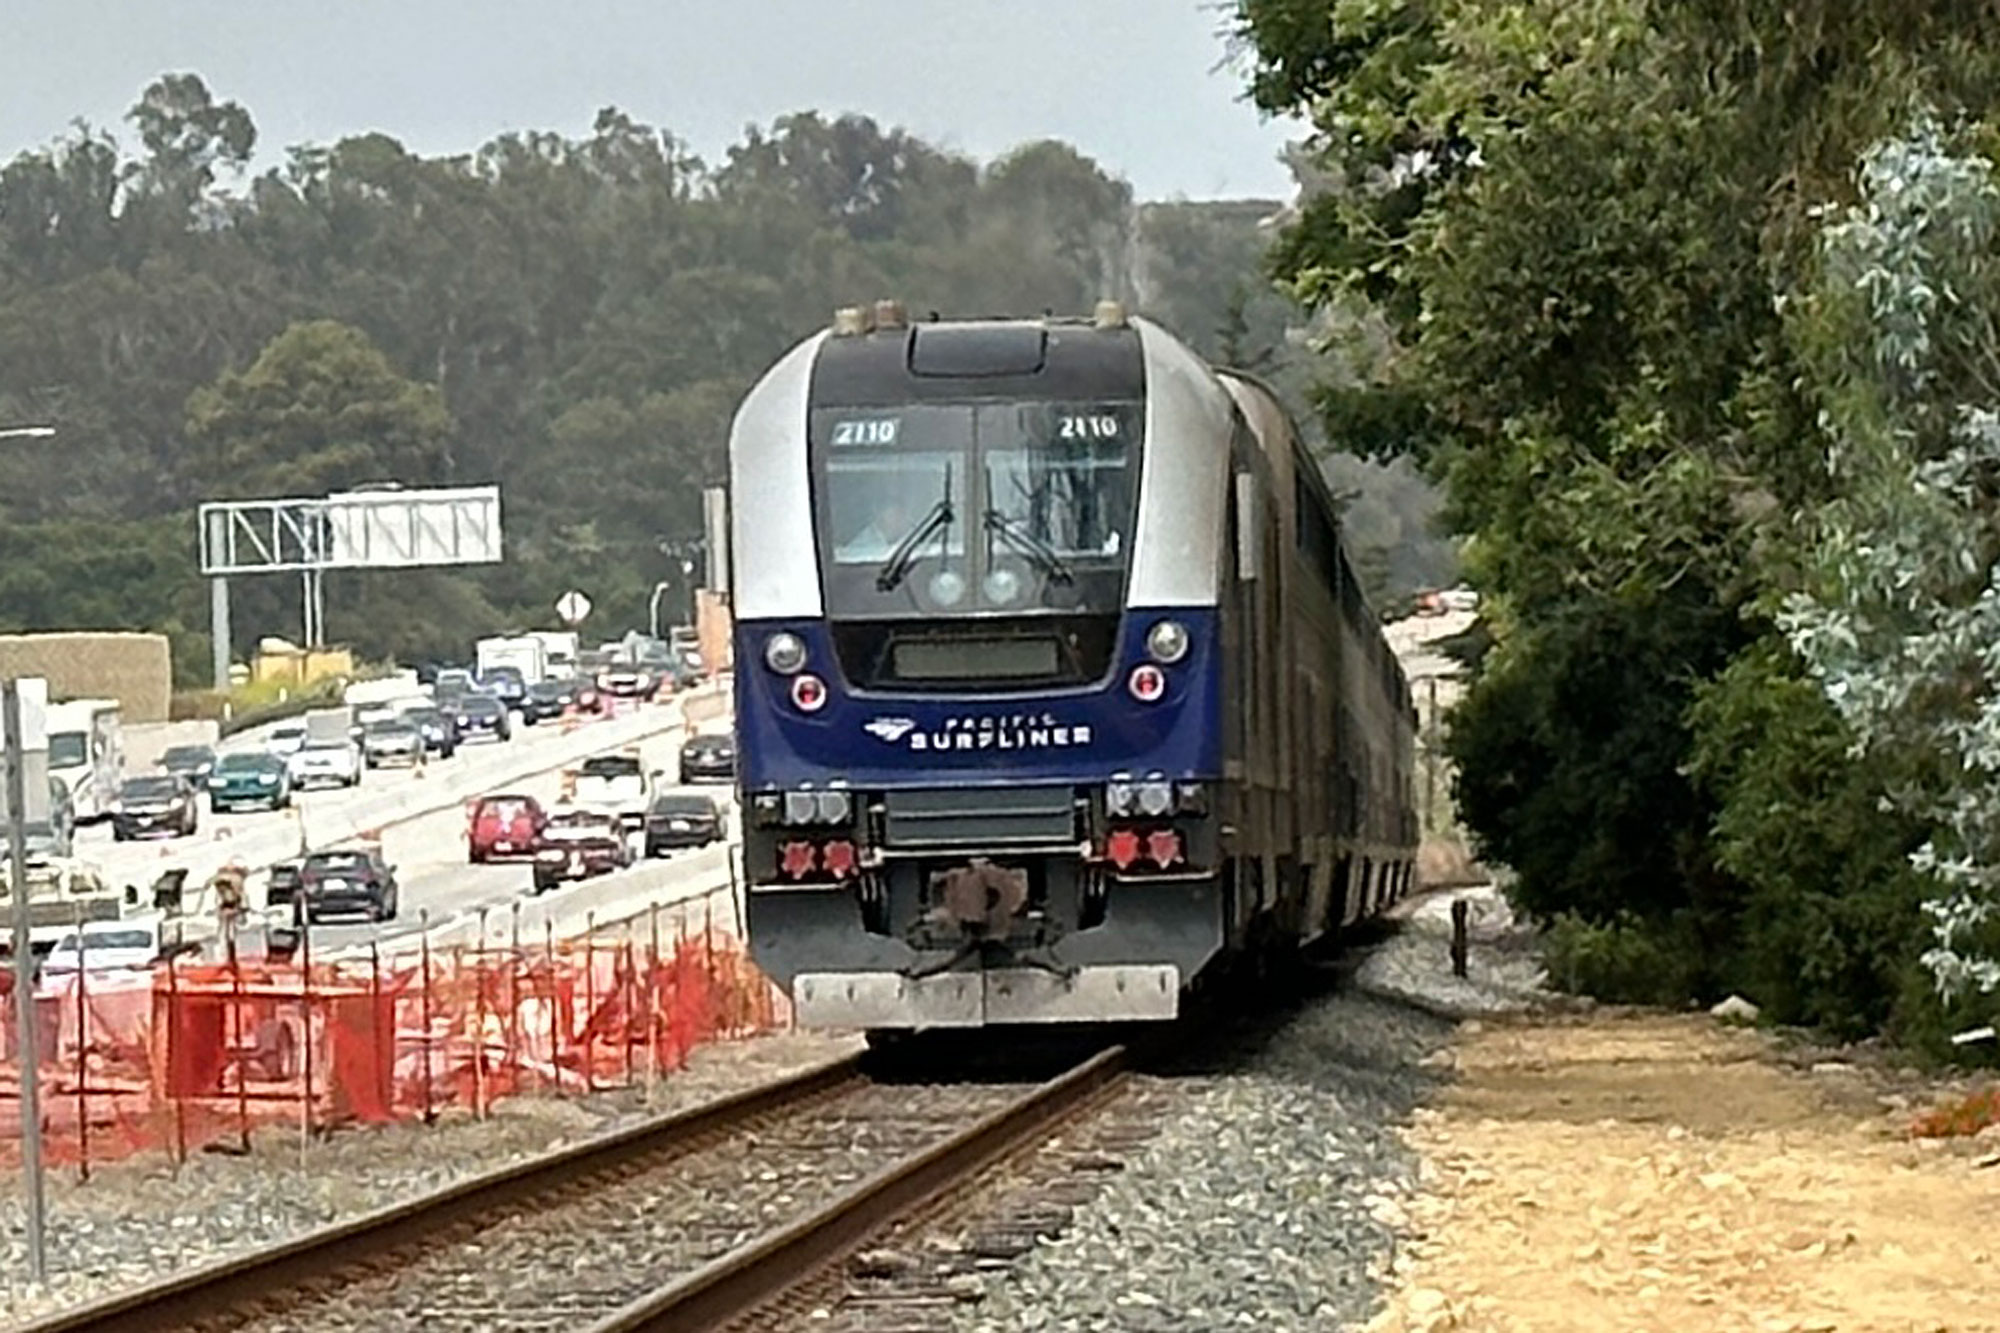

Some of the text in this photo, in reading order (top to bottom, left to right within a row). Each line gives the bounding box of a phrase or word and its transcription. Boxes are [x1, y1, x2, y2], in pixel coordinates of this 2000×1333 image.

[835, 419, 896, 444] 2110
[1059, 416, 1118, 438] 2110
[946, 713, 1056, 729] PACIFIC
[911, 726, 1091, 749] SURFLINER
